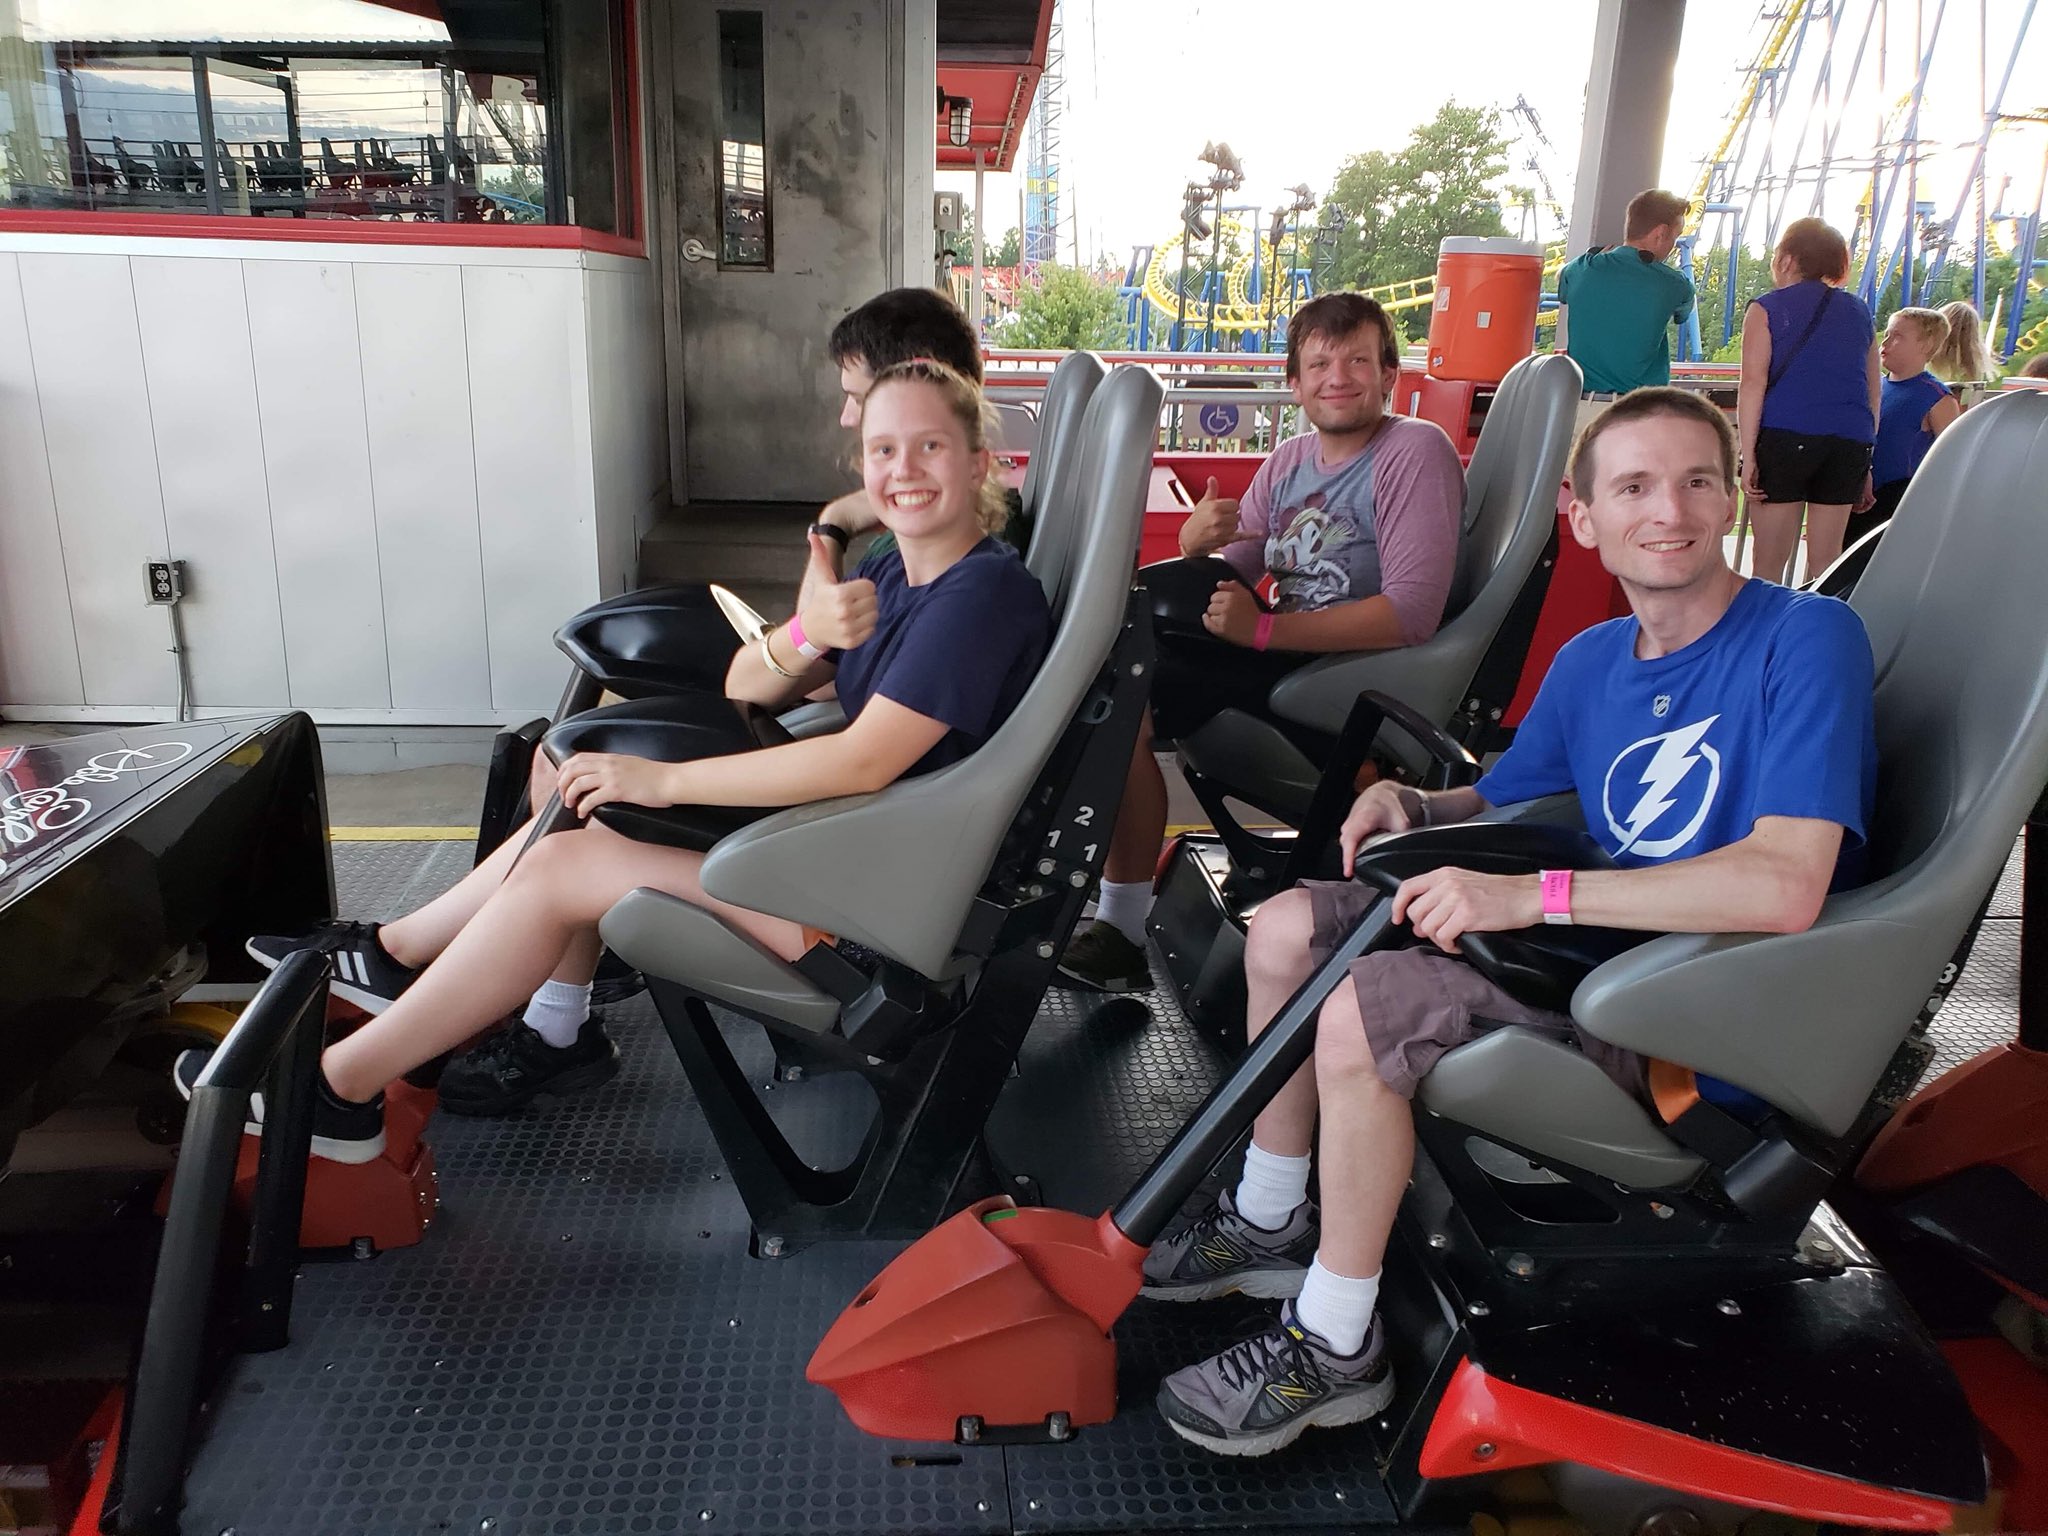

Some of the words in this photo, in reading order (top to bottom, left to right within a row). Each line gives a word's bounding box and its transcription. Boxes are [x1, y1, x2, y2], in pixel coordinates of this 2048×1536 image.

[1073, 805, 1095, 827] 2
[1047, 829, 1062, 849] 1
[1083, 843, 1098, 862] 1
[1937, 961, 1959, 984] 3
